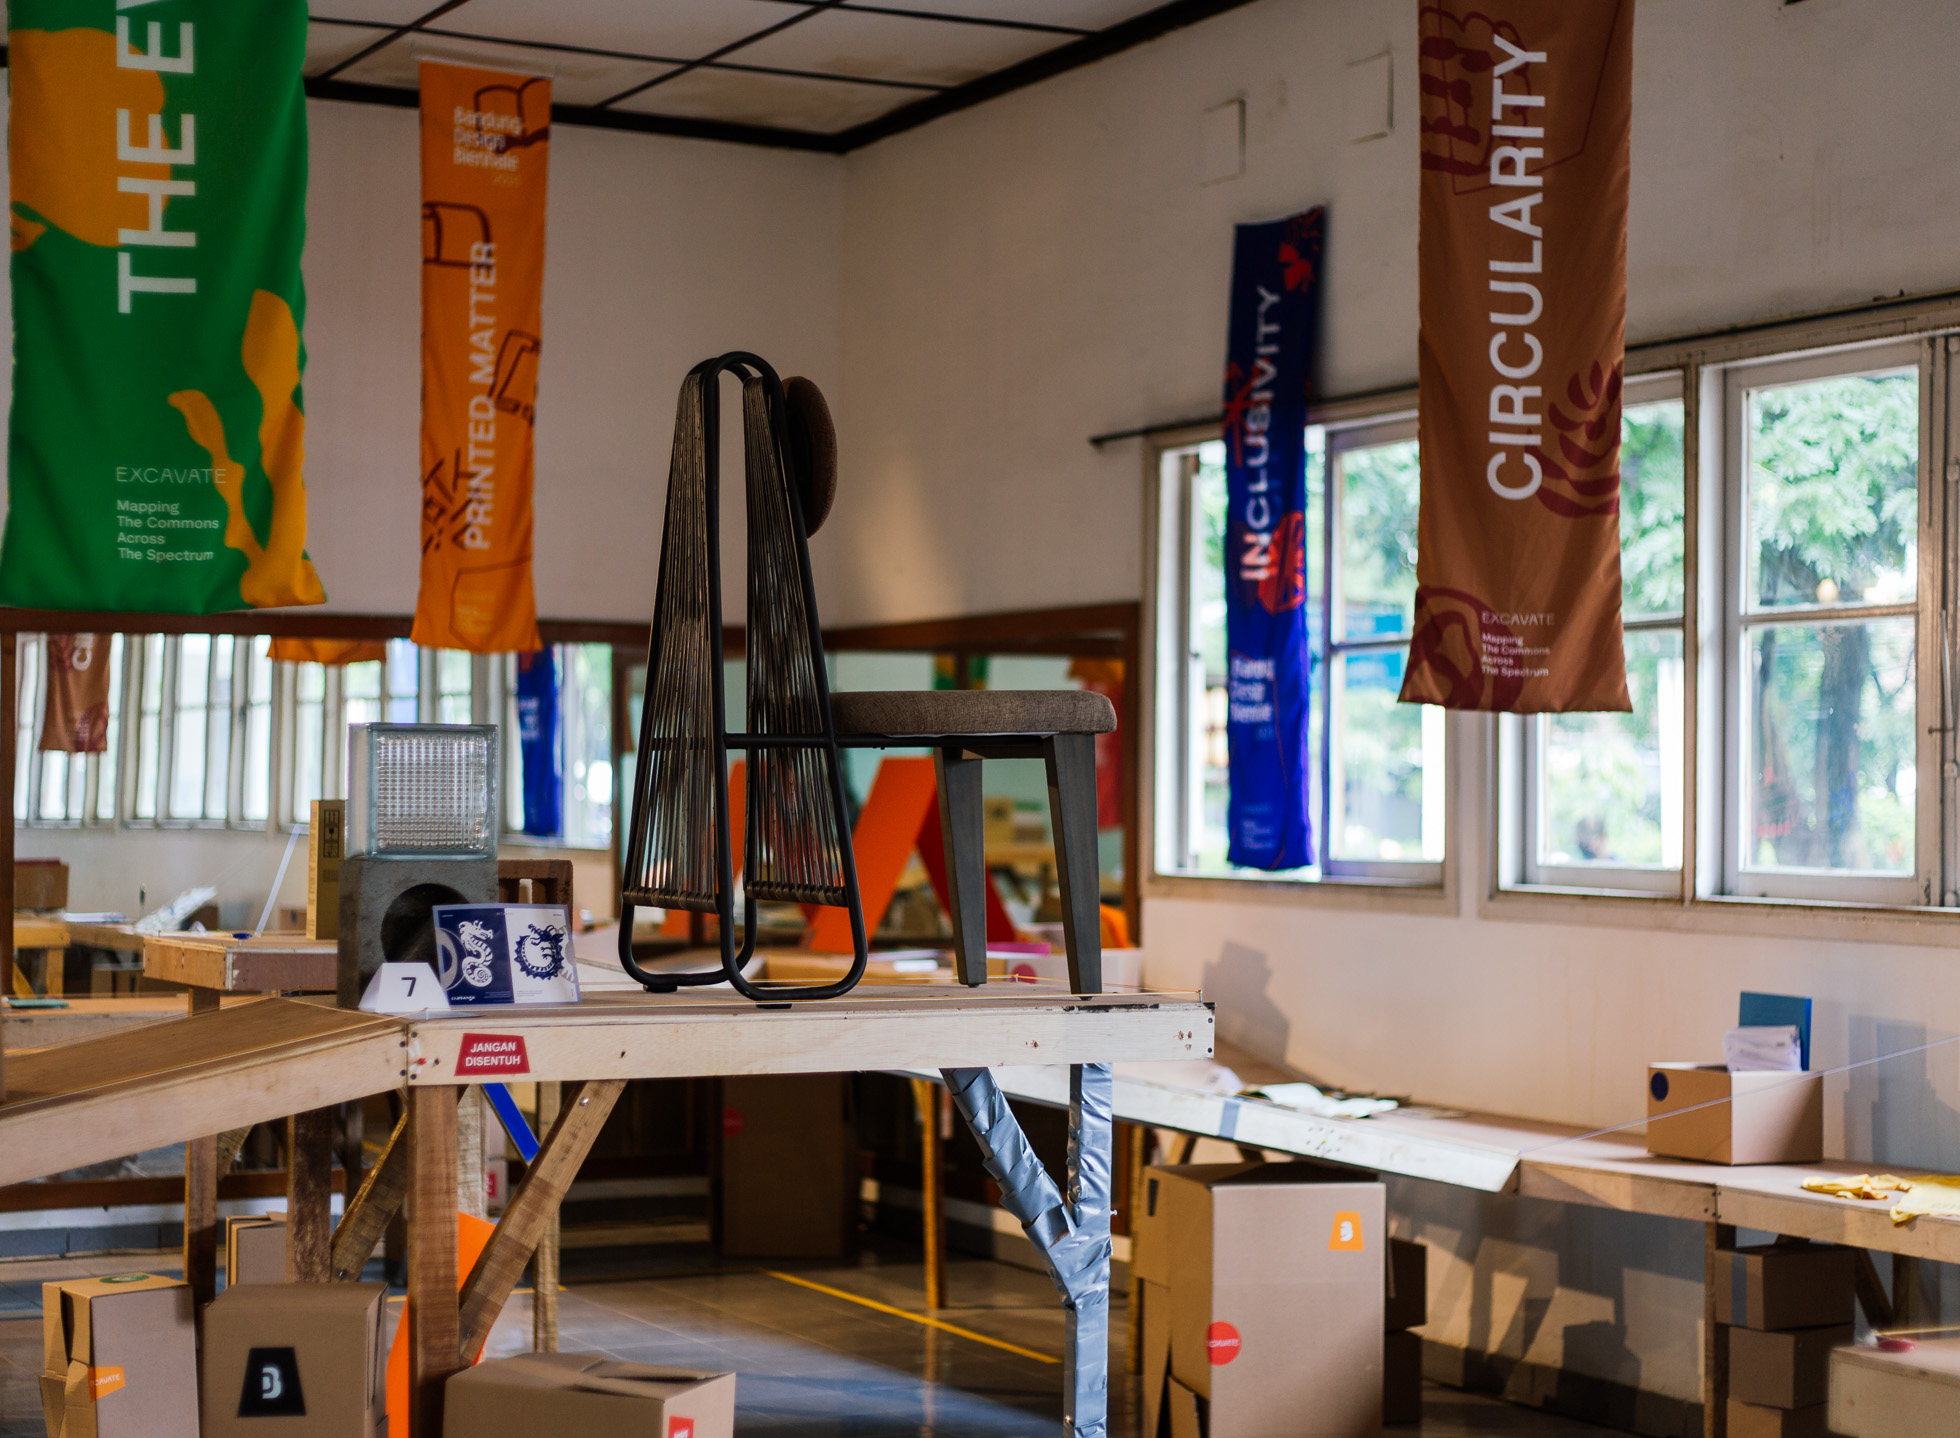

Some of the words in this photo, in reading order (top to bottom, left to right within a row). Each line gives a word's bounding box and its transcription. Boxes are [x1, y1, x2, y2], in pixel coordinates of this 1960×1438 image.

[117, 107, 197, 314] THE
[1487, 34, 1547, 500] CIRCULARITY
[469, 241, 498, 385] MATTER
[1240, 285, 1281, 581] INCLUSIVITY
[116, 466, 227, 484] EXCAVATE
[464, 395, 497, 550] PRINTED
[116, 500, 180, 516] Mapping
[116, 516, 143, 528] The
[146, 517, 220, 529] Commons
[117, 532, 166, 545] Across
[117, 547, 143, 560] The
[146, 549, 214, 563] Spectrum
[1482, 610, 1555, 626] EXCAVATE
[1482, 632, 1523, 647] Mapping
[1501, 645, 1550, 656] Commons
[1501, 667, 1549, 678] Spectrum
[401, 976, 417, 998] 7
[470, 1042, 516, 1053] JANGAN
[465, 1055, 521, 1067] DISENTUH
